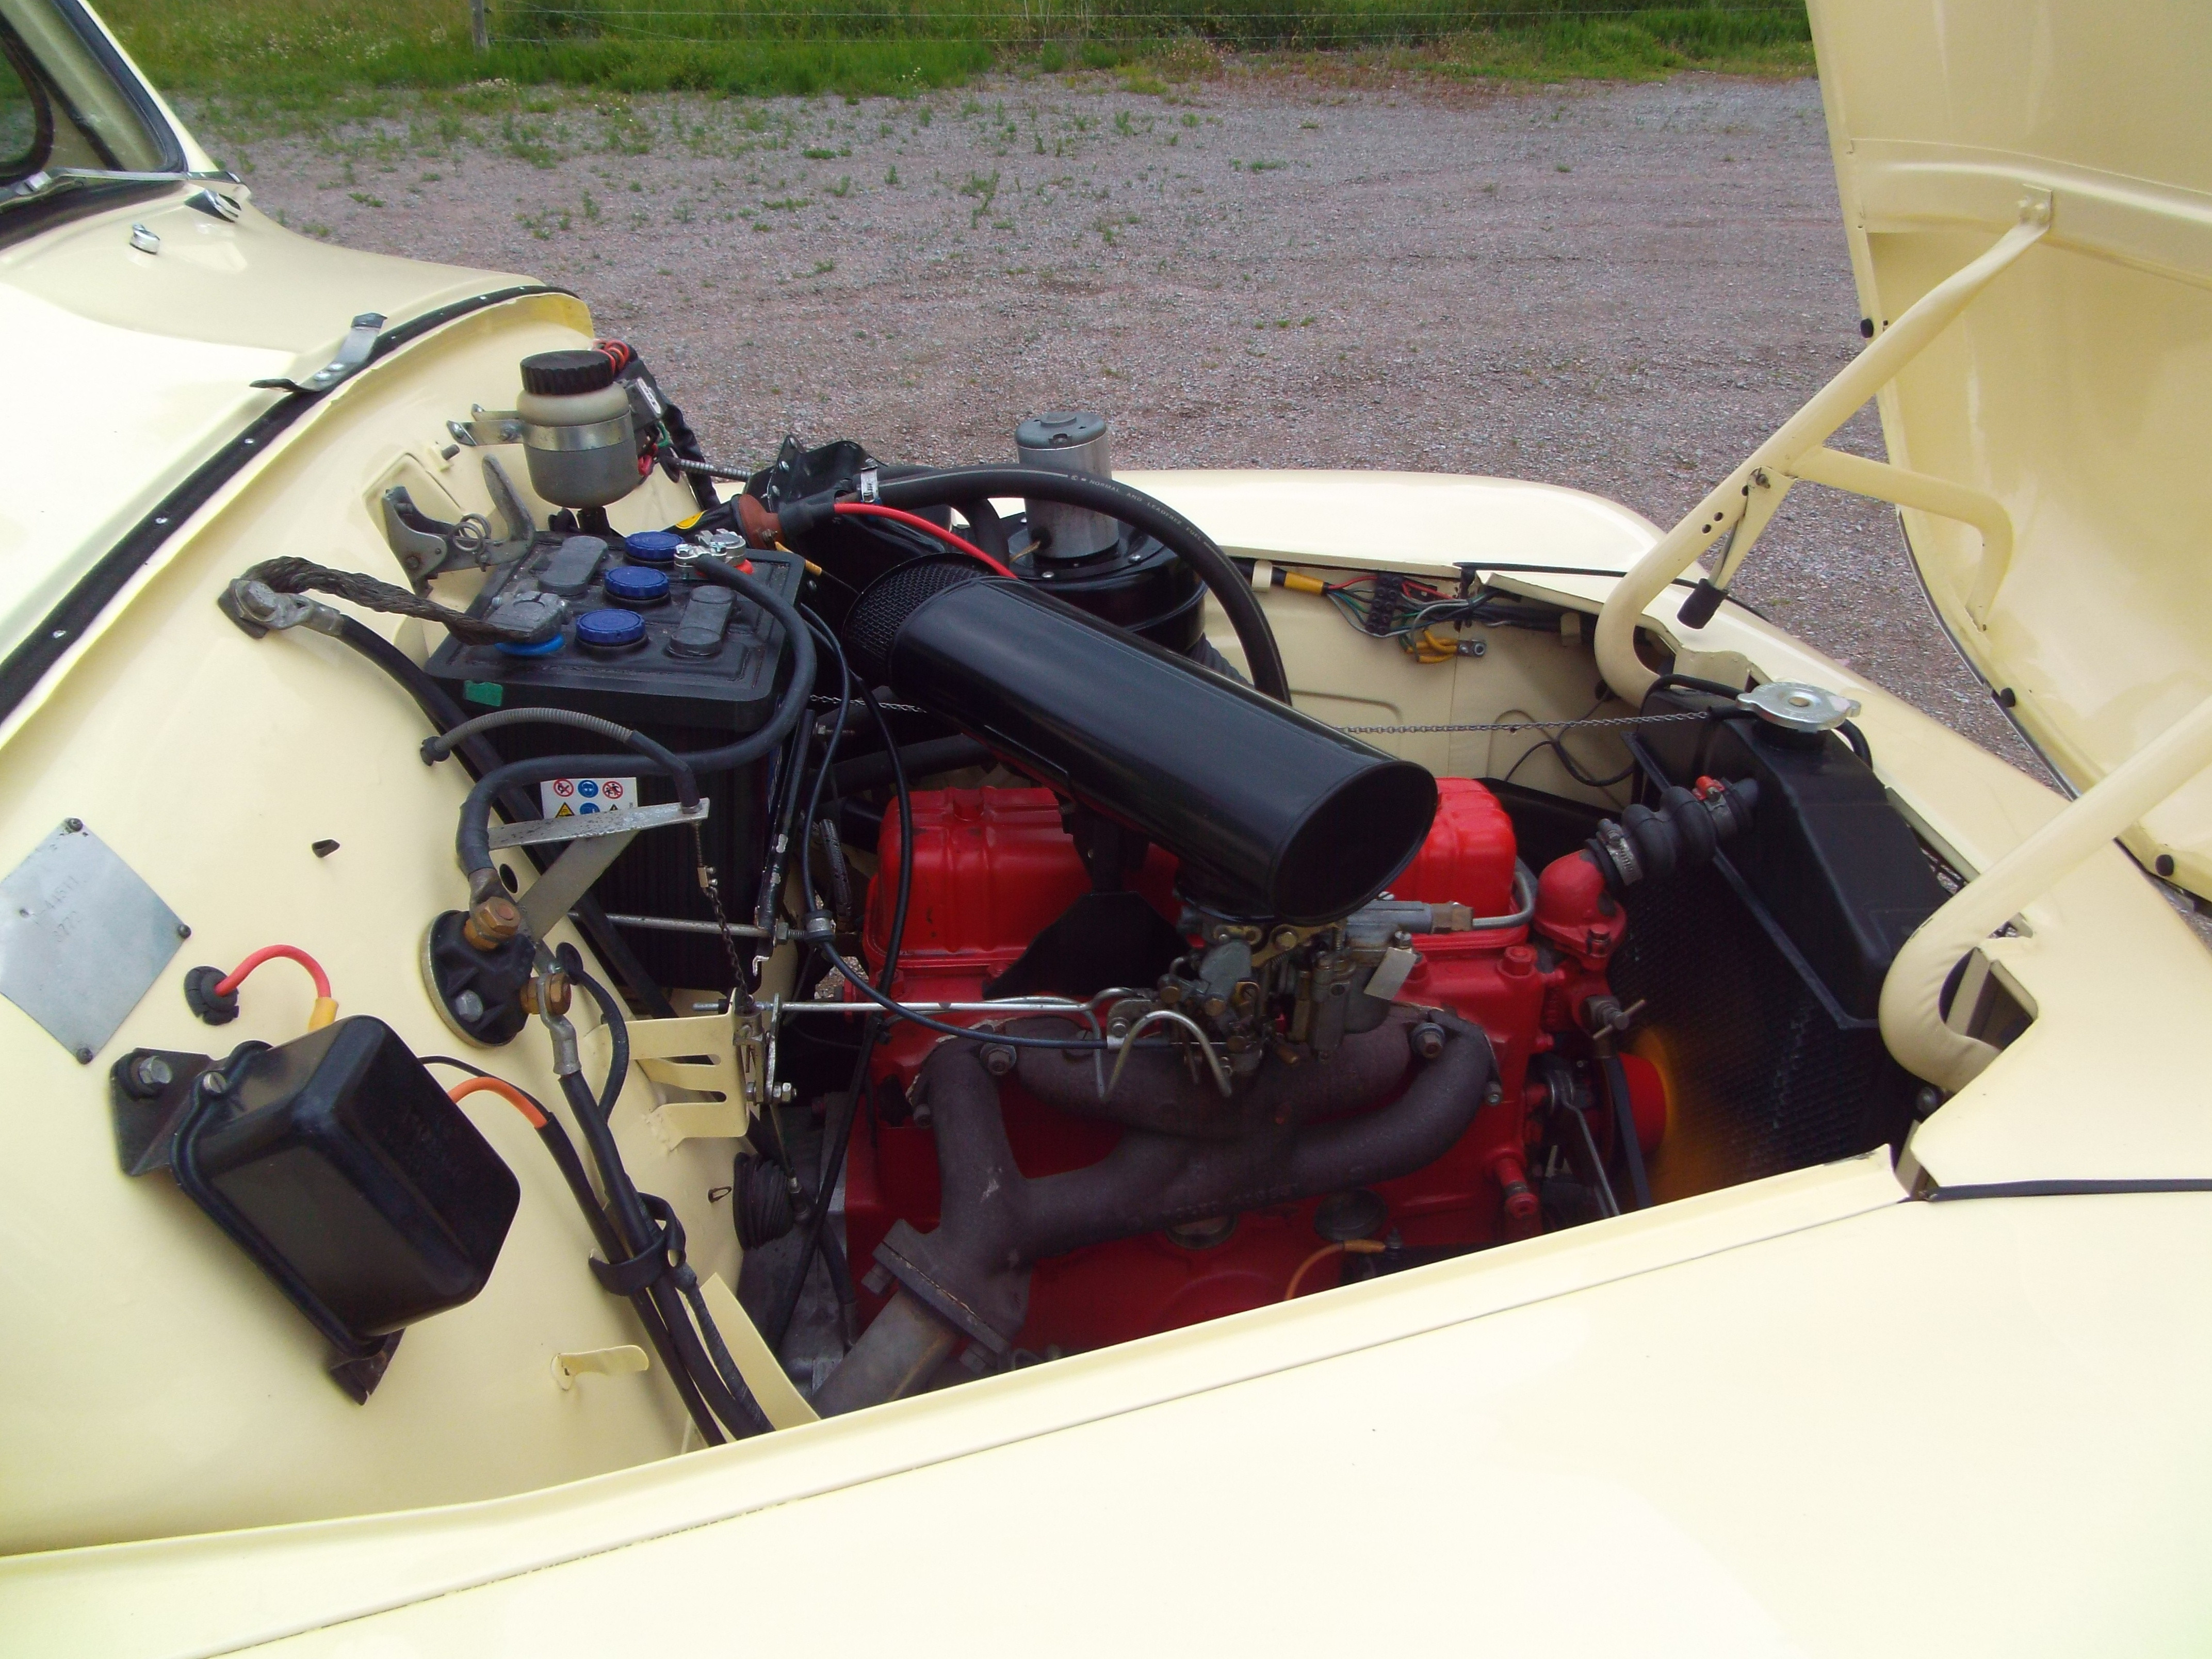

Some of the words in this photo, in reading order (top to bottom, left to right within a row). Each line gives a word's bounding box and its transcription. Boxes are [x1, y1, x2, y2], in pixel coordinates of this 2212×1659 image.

[1089, 480, 1119, 492] NORMAL
[1126, 493, 1142, 501] AND
[1147, 502, 1182, 525] LEADFREE
[1186, 527, 1201, 541] FUEL
